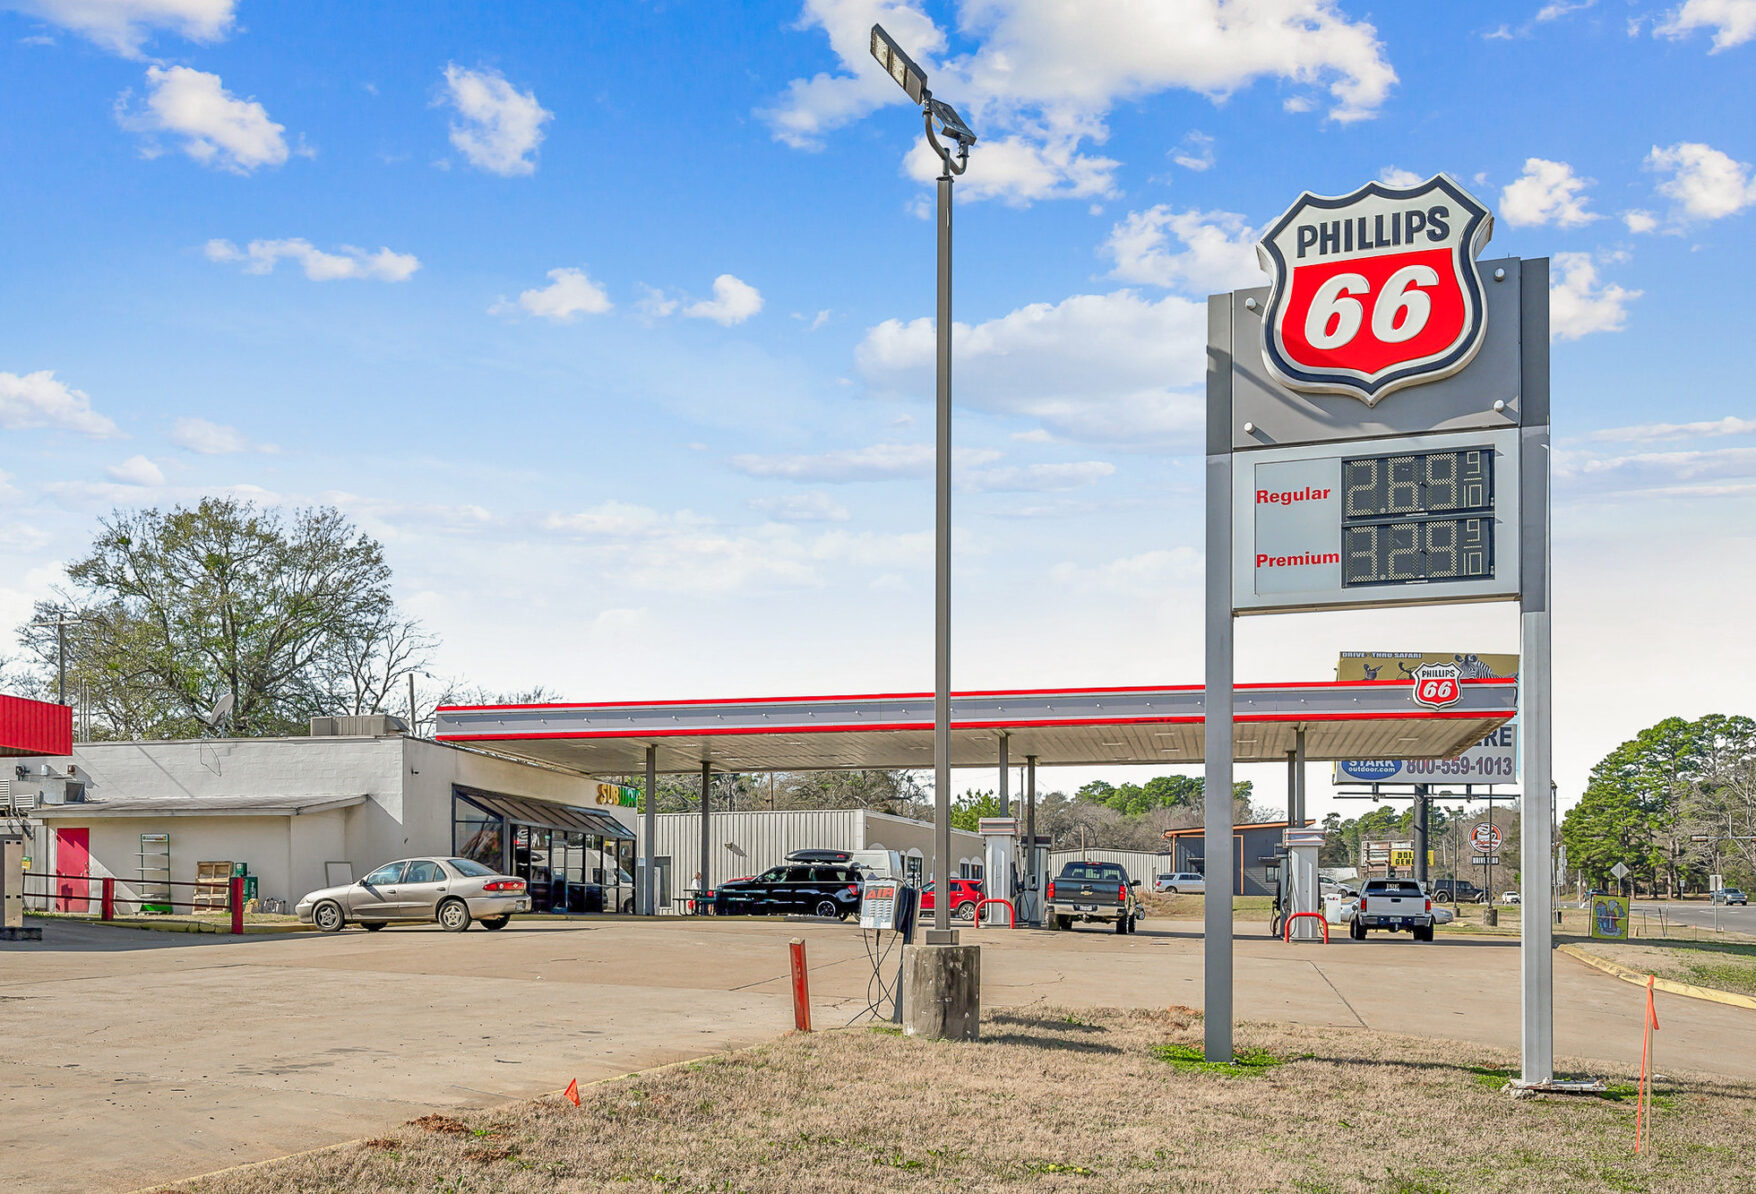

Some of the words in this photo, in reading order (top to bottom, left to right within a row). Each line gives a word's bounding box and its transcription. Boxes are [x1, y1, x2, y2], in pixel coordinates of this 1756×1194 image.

[1297, 205, 1450, 258] PHILLIPS
[1304, 264, 1440, 350] 66
[1256, 486, 1331, 506] Regular
[1256, 551, 1340, 569] Premium
[1342, 651, 1366, 659] DRIVE
[1421, 669, 1456, 678] PHILLIPS
[1423, 681, 1453, 698] 66
[1406, 756, 1512, 776] 800-559-1013
[597, 783, 640, 808] SUBWAY
[864, 887, 895, 900] AIR
